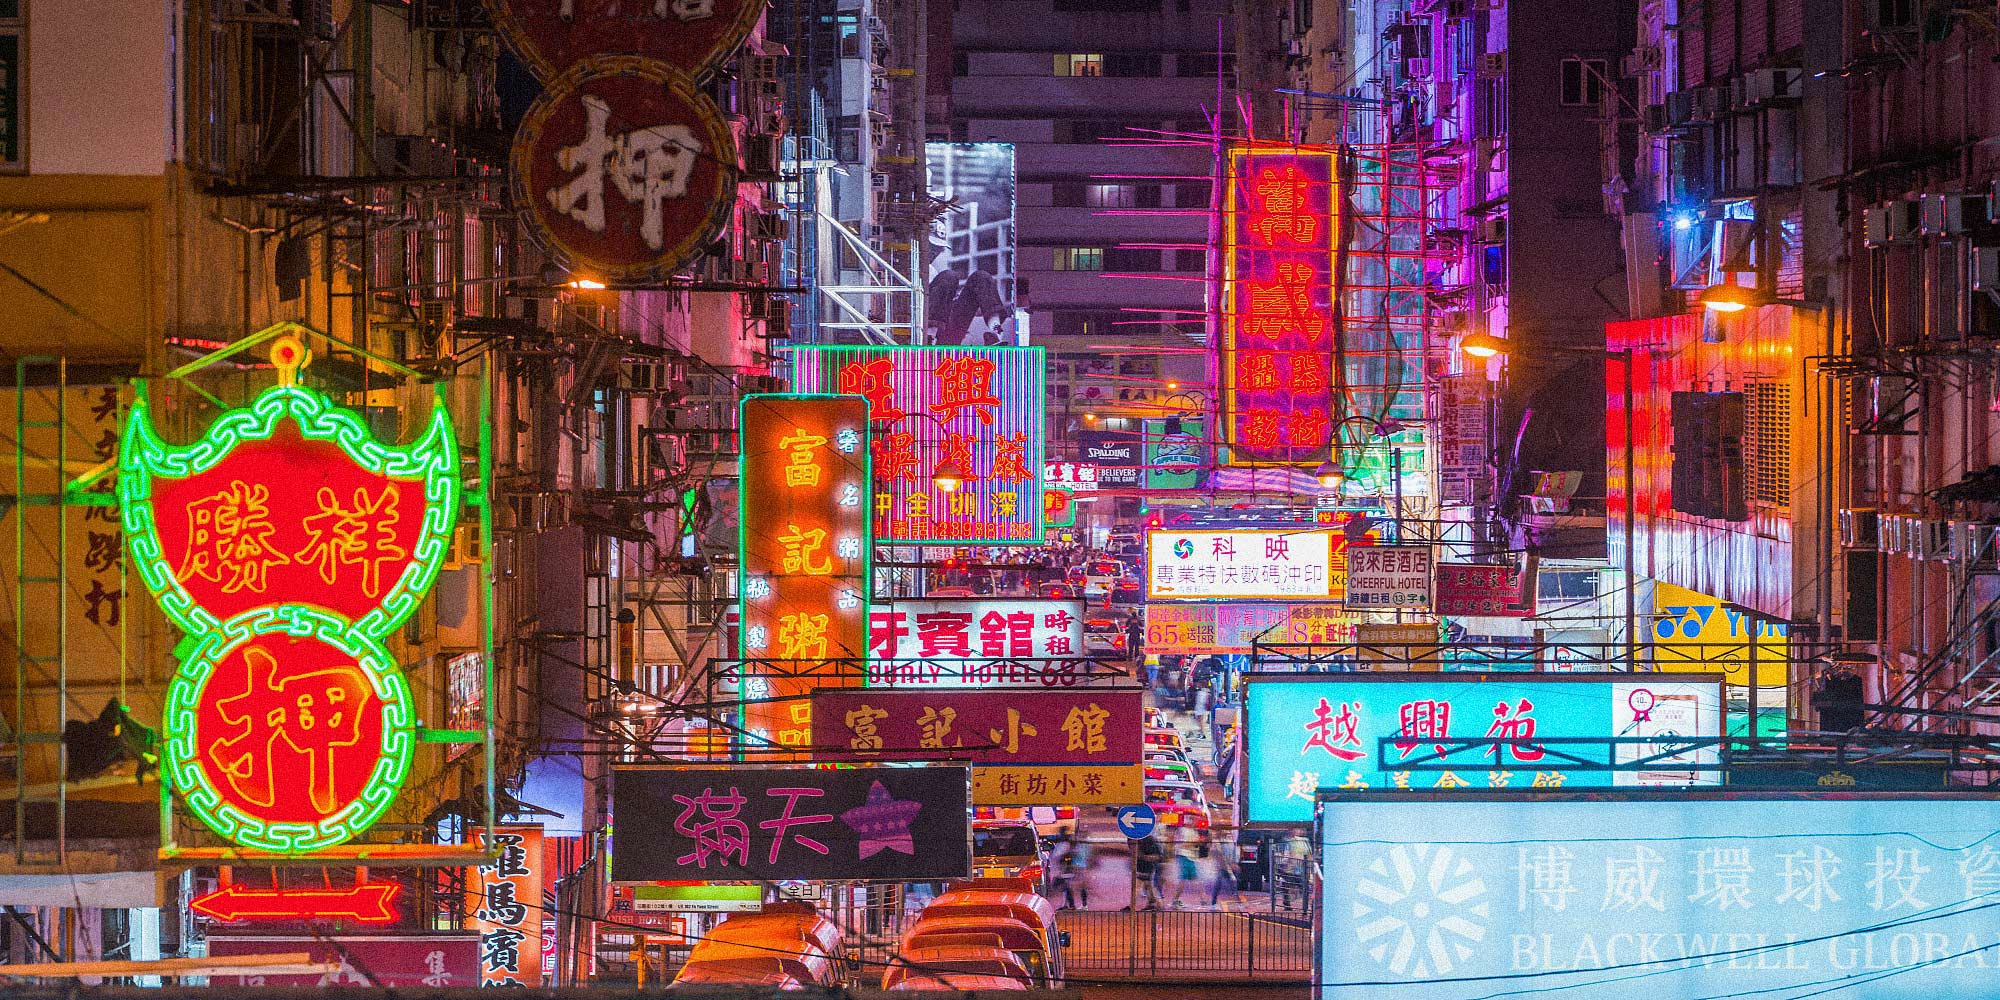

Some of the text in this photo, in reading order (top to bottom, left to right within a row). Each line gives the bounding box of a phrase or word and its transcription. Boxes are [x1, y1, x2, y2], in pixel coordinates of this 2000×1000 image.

[546, 94, 701, 250] 押
[1088, 447, 1130, 459] SPALDING
[1101, 468, 1137, 477] BELIEVERS
[1212, 535, 1290, 562] 科映
[1350, 550, 1427, 573] 悅來居酒店
[777, 428, 833, 747] 富記粥品
[1350, 577, 1427, 590] CHEERFUL HOTEL
[1043, 609, 1075, 656] 時租
[1187, 625, 1216, 641] 送 12R
[1196, 635, 1216, 644] 18R
[1293, 622, 1309, 643] 8
[961, 664, 1032, 685] HOTEL
[1039, 660, 1078, 688] 68
[208, 647, 371, 813] 押
[844, 703, 1111, 756] 富記小館
[999, 772, 1104, 796] 街坊小菜
[788, 885, 814, 898] 全日
[1510, 845, 2000, 913] 博威環球投資
[478, 833, 531, 989] 羅馬賓
[1511, 932, 1809, 971] BLACKWELL
